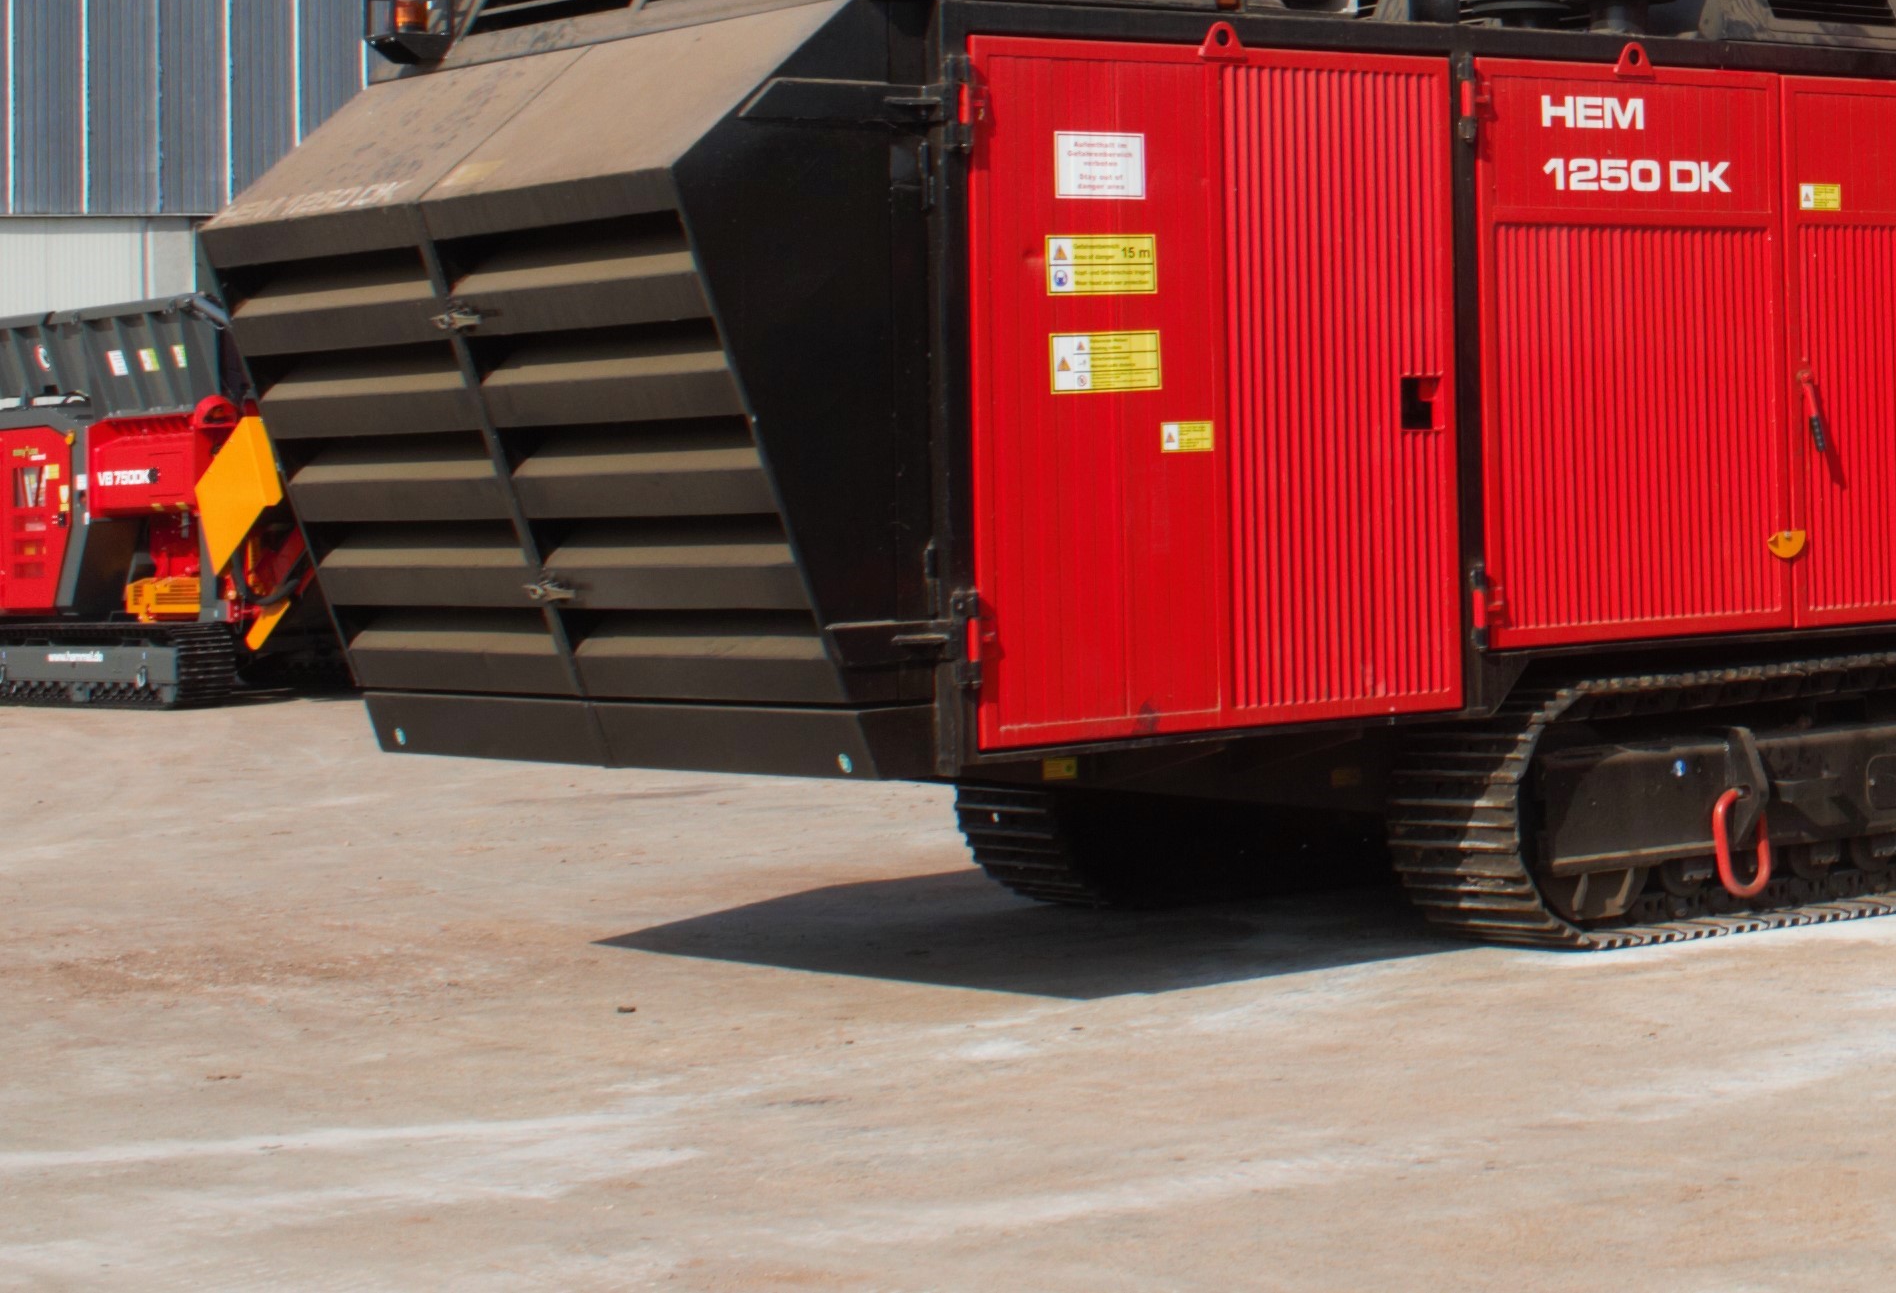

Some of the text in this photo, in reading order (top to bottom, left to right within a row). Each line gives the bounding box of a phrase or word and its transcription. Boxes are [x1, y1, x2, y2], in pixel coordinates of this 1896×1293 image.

[1541, 95, 1644, 130] HEM
[1543, 158, 1732, 193] 1250 DK
[1121, 246, 1151, 259] 15 m
